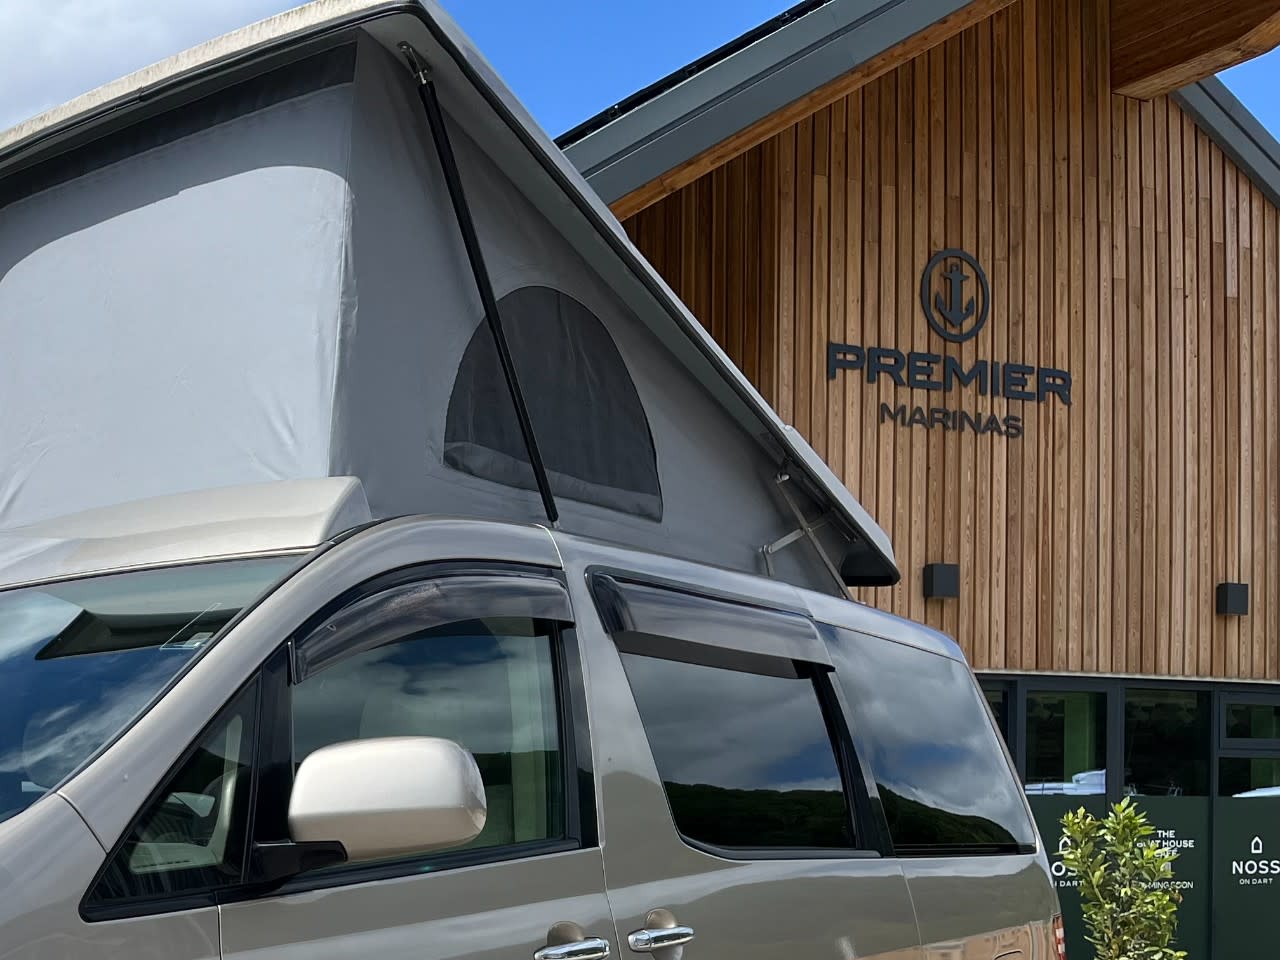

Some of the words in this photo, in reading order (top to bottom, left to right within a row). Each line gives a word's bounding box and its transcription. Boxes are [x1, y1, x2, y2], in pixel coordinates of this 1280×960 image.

[827, 342, 1072, 406] PREMIER
[879, 402, 1022, 439] MARINAS
[1157, 830, 1175, 838] THE
[1162, 840, 1195, 848] HOUSE
[1232, 860, 1280, 875] NOSS
